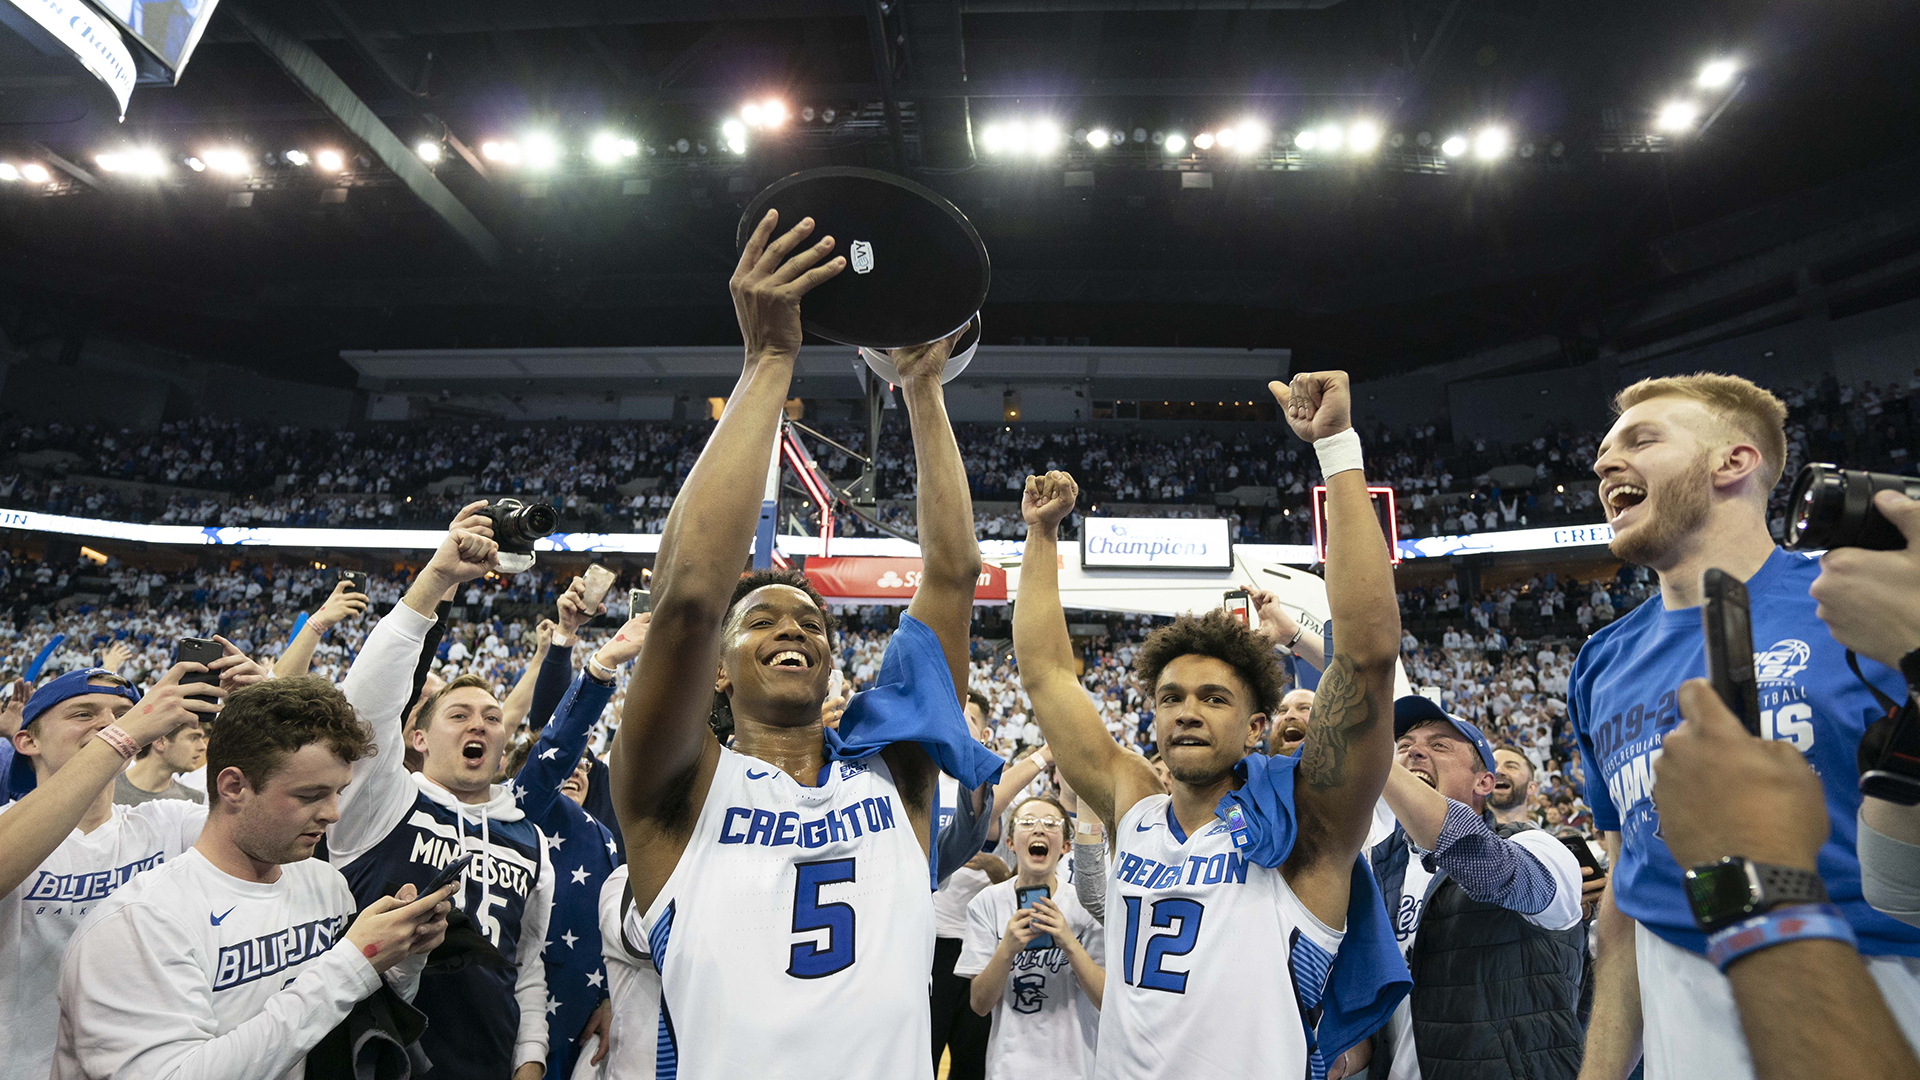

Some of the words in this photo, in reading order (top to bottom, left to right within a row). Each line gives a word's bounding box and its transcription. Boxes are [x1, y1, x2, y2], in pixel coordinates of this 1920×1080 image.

[1088, 535, 1207, 561] Champions
[1763, 685, 1807, 708] TBALL
[840, 761, 858, 773] BIG
[841, 763, 868, 779] EAST
[718, 795, 896, 849] CREIGHTON
[409, 831, 528, 900] MINESOTA
[785, 857, 856, 979] 5
[1122, 895, 1205, 995] 12
